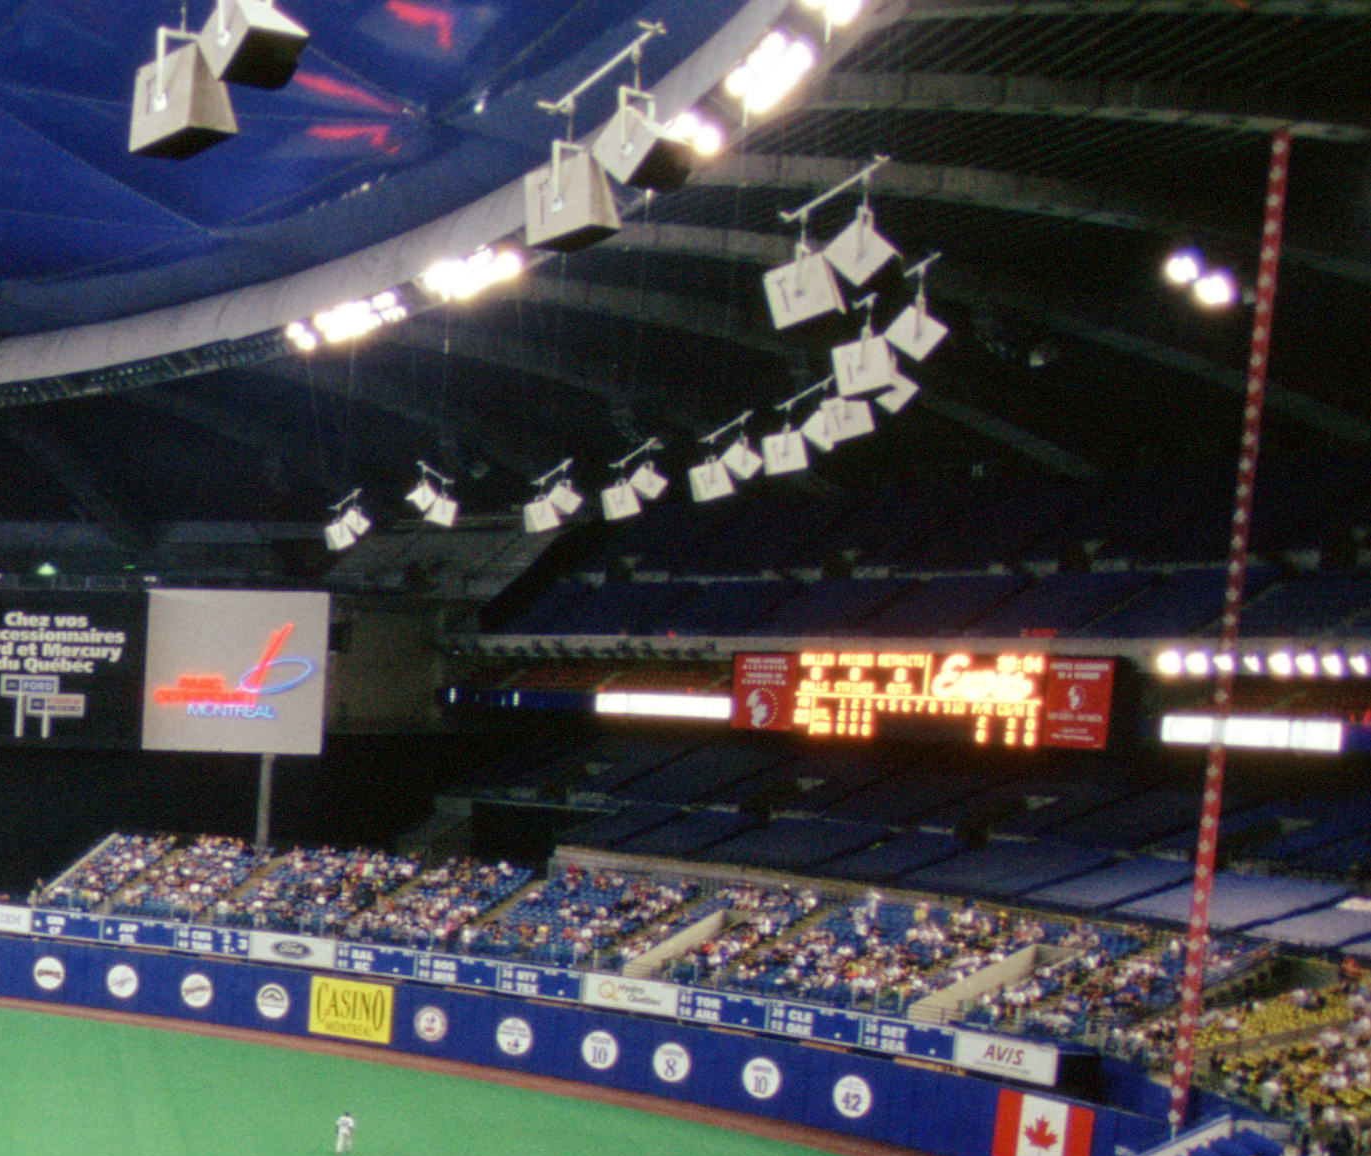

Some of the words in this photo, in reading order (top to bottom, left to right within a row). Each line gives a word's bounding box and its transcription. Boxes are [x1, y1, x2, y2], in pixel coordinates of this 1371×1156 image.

[4, 611, 51, 628] Chez
[54, 615, 88, 628] vos
[16, 642, 38, 656] et
[41, 643, 122, 663] Mercury
[23, 657, 94, 673] Québec
[316, 981, 385, 1031] CASINO
[788, 1009, 814, 1024] CLE
[591, 1045, 608, 1065] 10
[983, 1043, 1025, 1066] AVIS
[664, 1057, 677, 1078] 8
[753, 1075, 768, 1094] 10
[841, 1091, 862, 1112] 42
